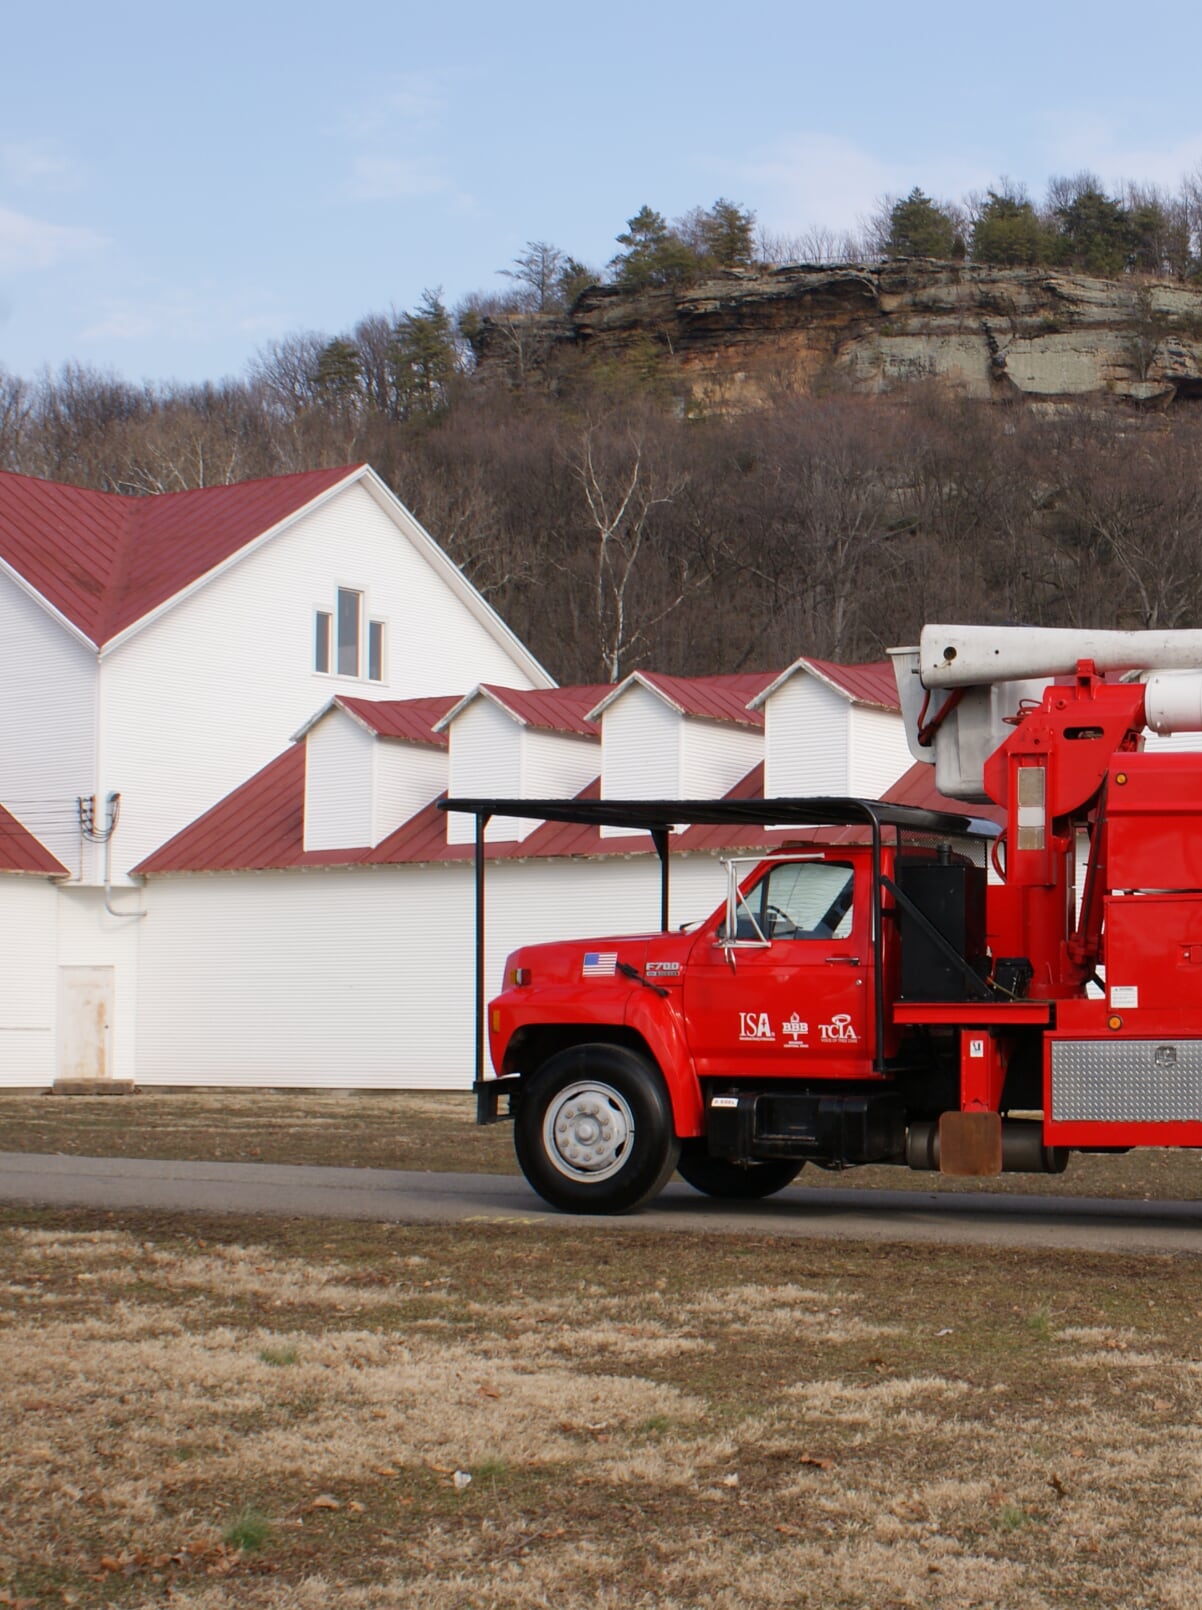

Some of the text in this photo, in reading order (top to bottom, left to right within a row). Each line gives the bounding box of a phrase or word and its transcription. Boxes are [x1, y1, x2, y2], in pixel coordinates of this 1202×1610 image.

[646, 962, 679, 971] F700
[739, 1012, 772, 1037] ISA
[782, 1022, 808, 1033] BBB
[818, 1021, 857, 1039] TCIA
